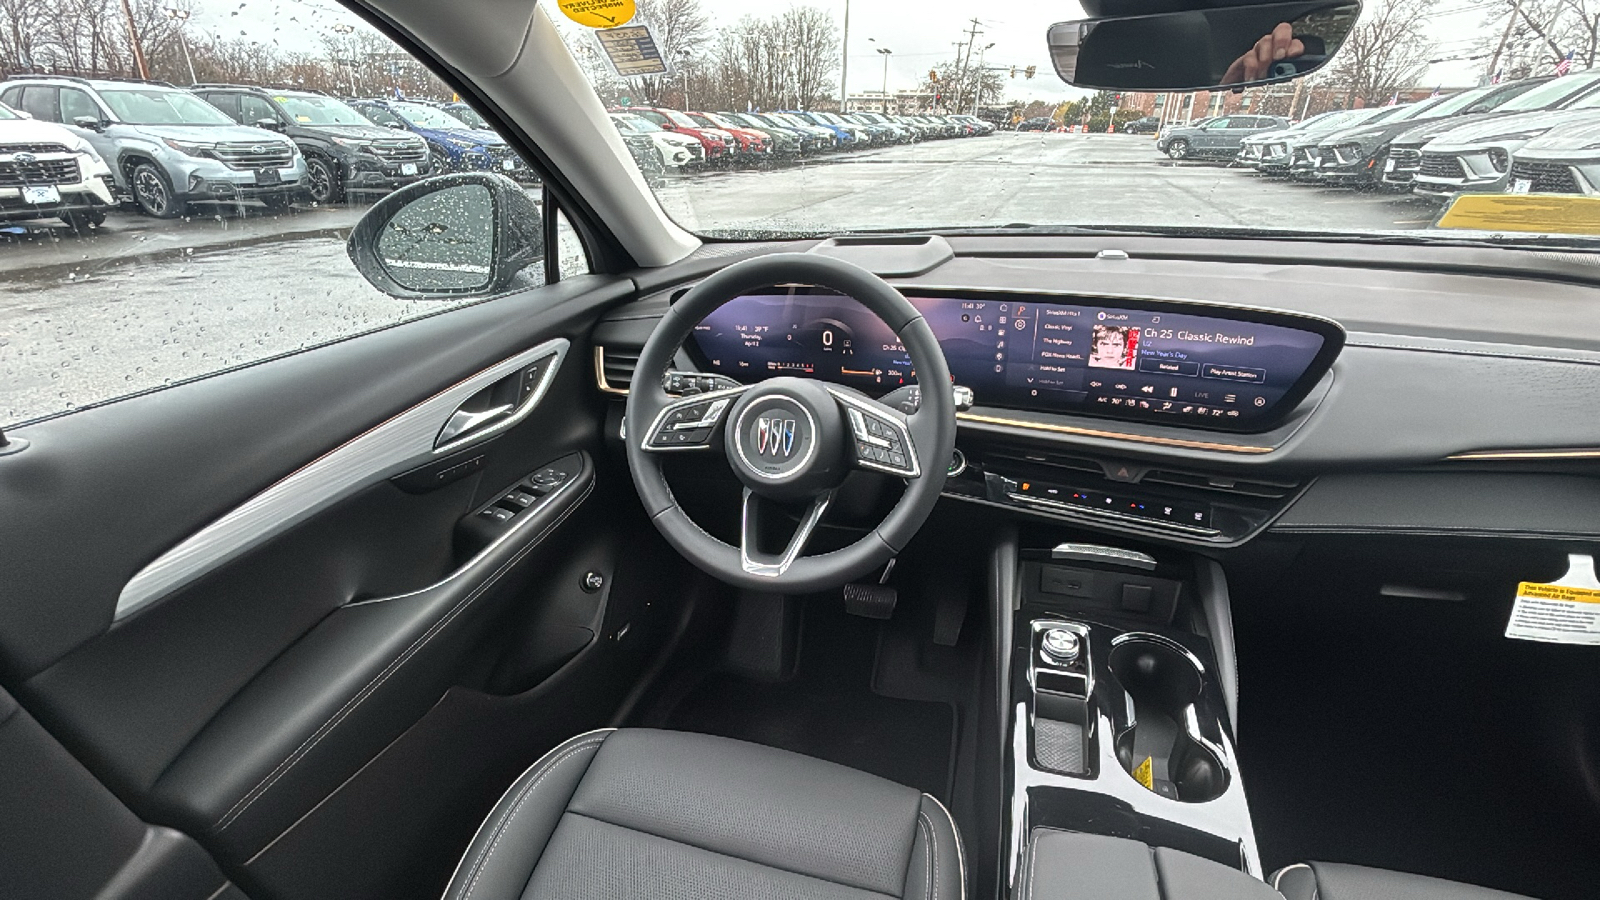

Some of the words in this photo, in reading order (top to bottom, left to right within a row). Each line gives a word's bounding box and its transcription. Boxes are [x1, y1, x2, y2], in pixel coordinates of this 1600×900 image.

[823, 330, 833, 346] 0
[1144, 328, 1158, 338] Ch
[1160, 329, 1174, 339] 25
[1177, 331, 1212, 343] Classic
[1214, 333, 1255, 346] Rewind
[1156, 350, 1174, 358] Year's
[1174, 351, 1188, 360] Day
[1210, 368, 1221, 376] Play
